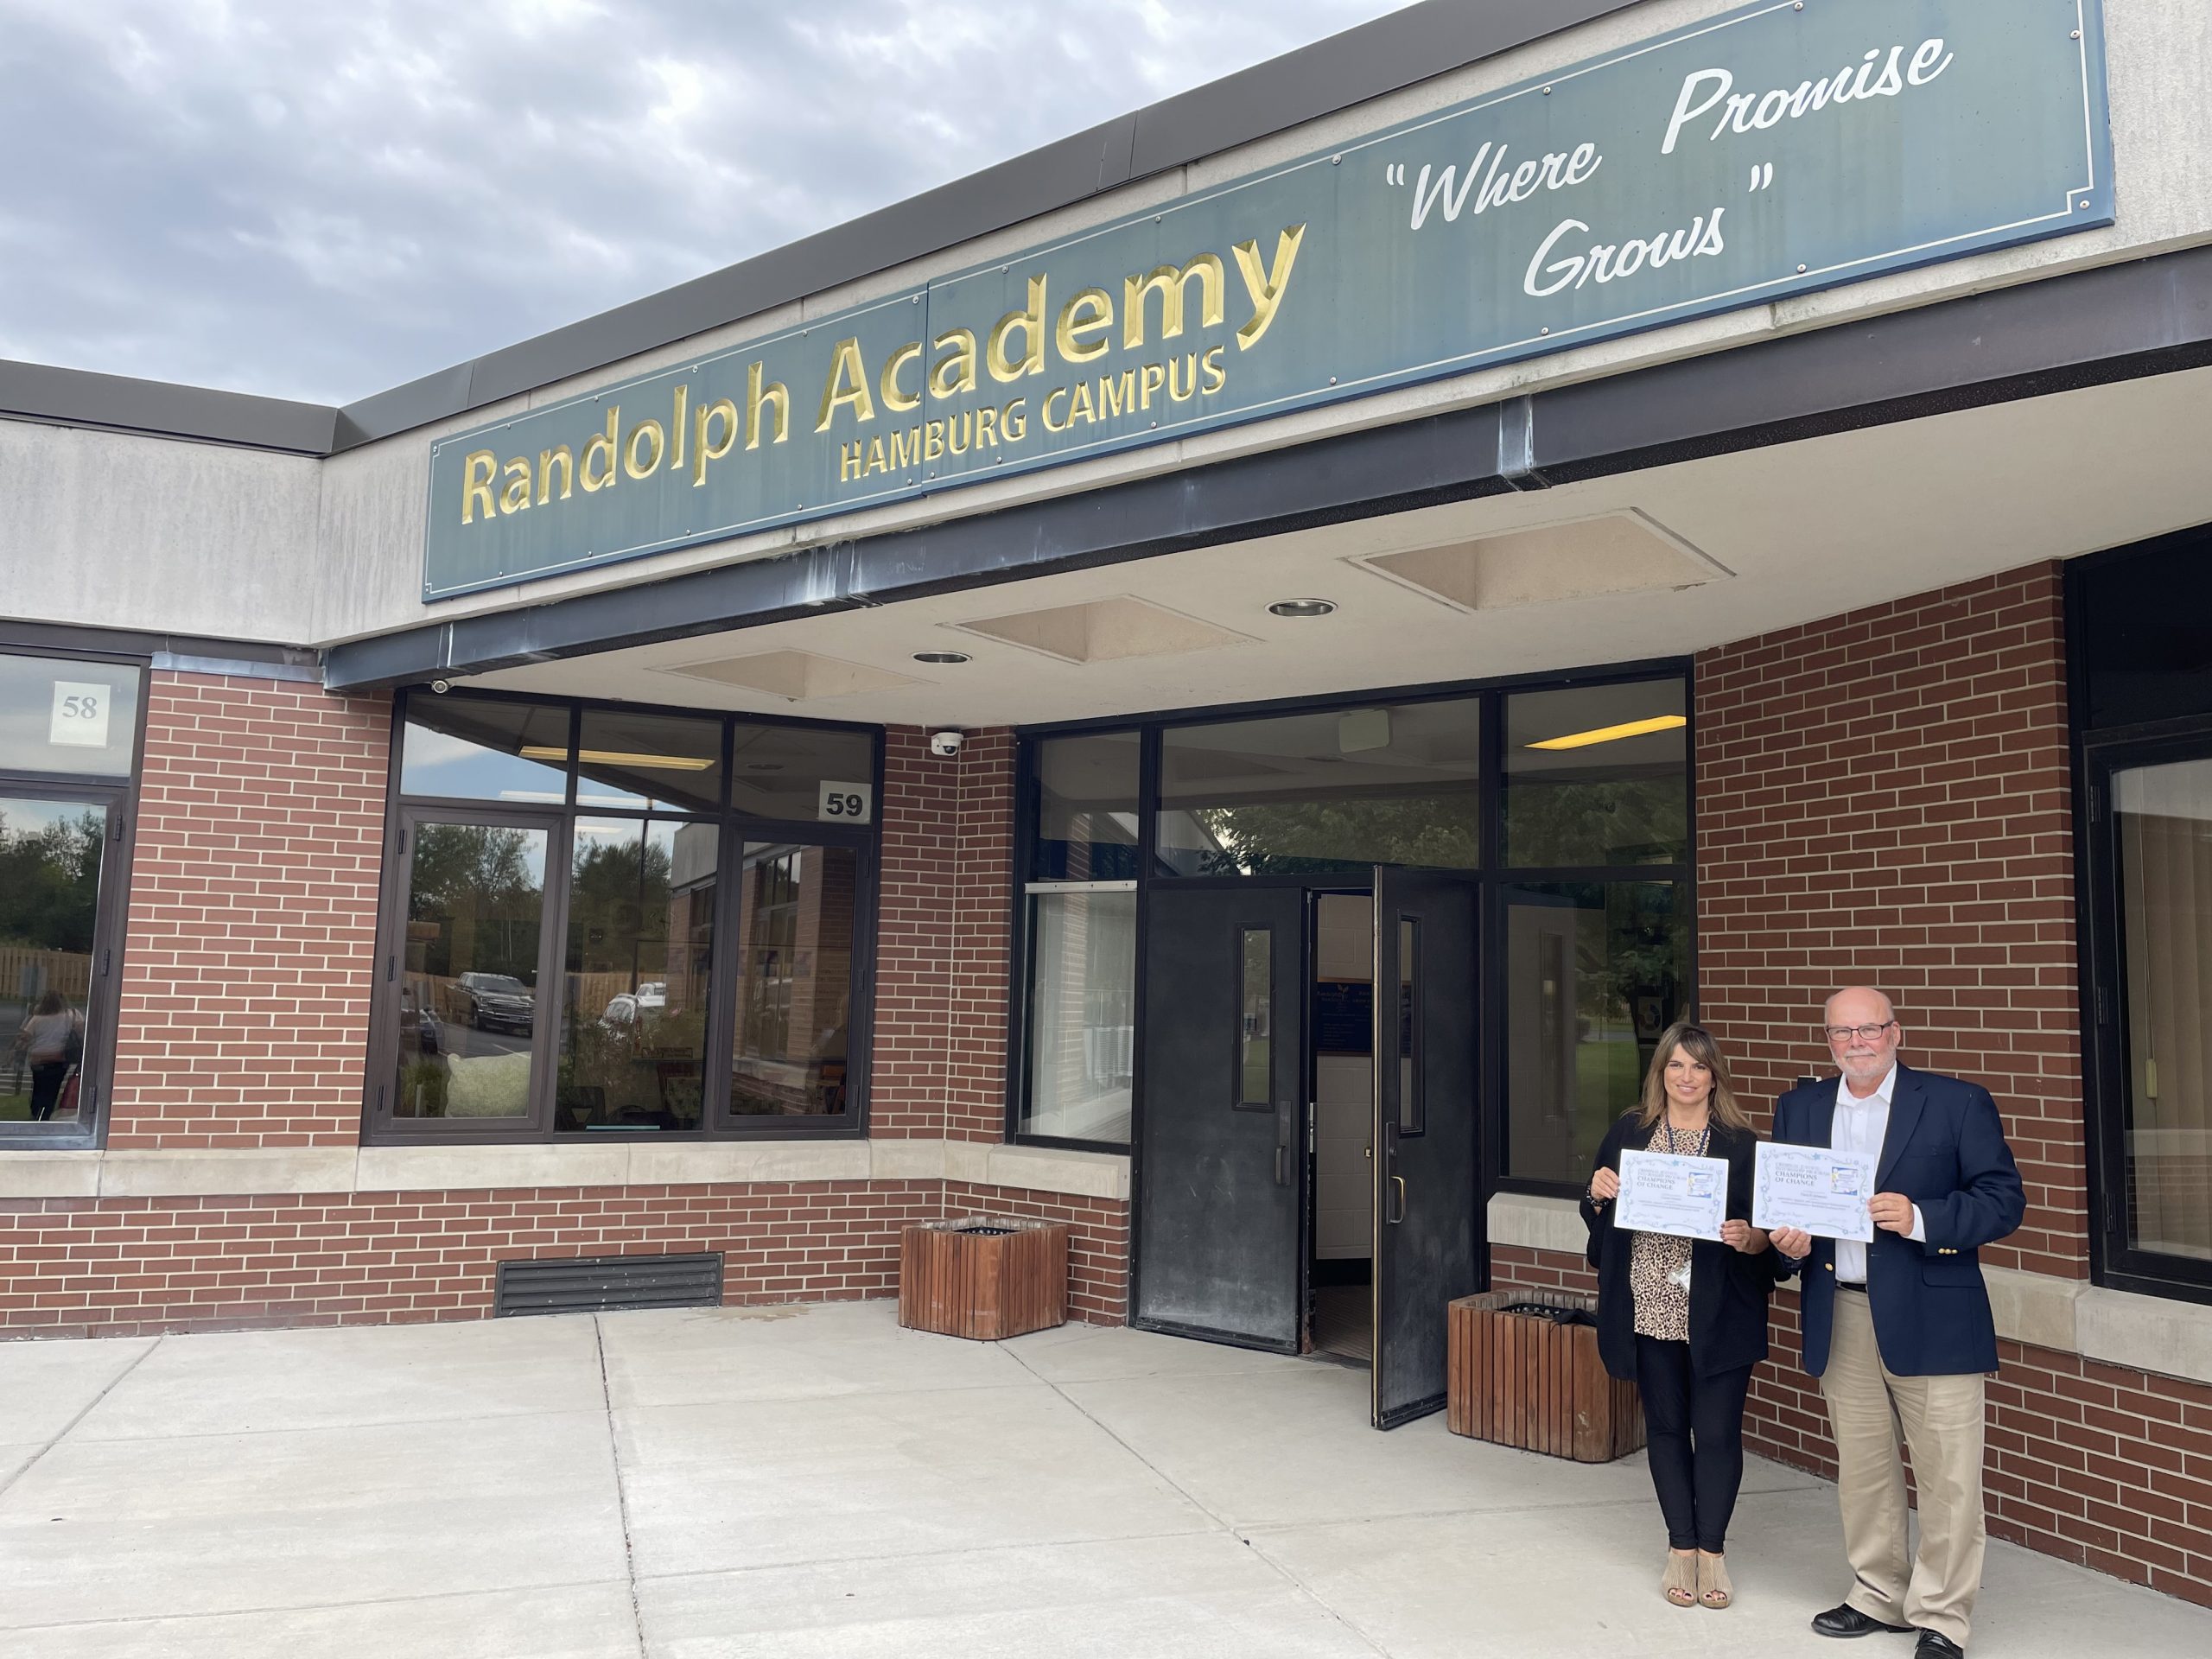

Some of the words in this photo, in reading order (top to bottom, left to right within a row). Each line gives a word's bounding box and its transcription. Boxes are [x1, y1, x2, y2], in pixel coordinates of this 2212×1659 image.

[1661, 38, 1954, 154] Promise
[461, 360, 790, 525] Randolph
[815, 222, 1307, 434] Academy
[840, 397, 1027, 483] HAMBURG
[1042, 345, 1226, 433] CAMPUS
[62, 696, 98, 719] 58
[826, 792, 863, 817] 59
[1637, 1175, 1675, 1185] CHAMPIONS
[1775, 1171, 1817, 1180] CHAMPIONS
[1786, 1178, 1815, 1186] CHANGE
